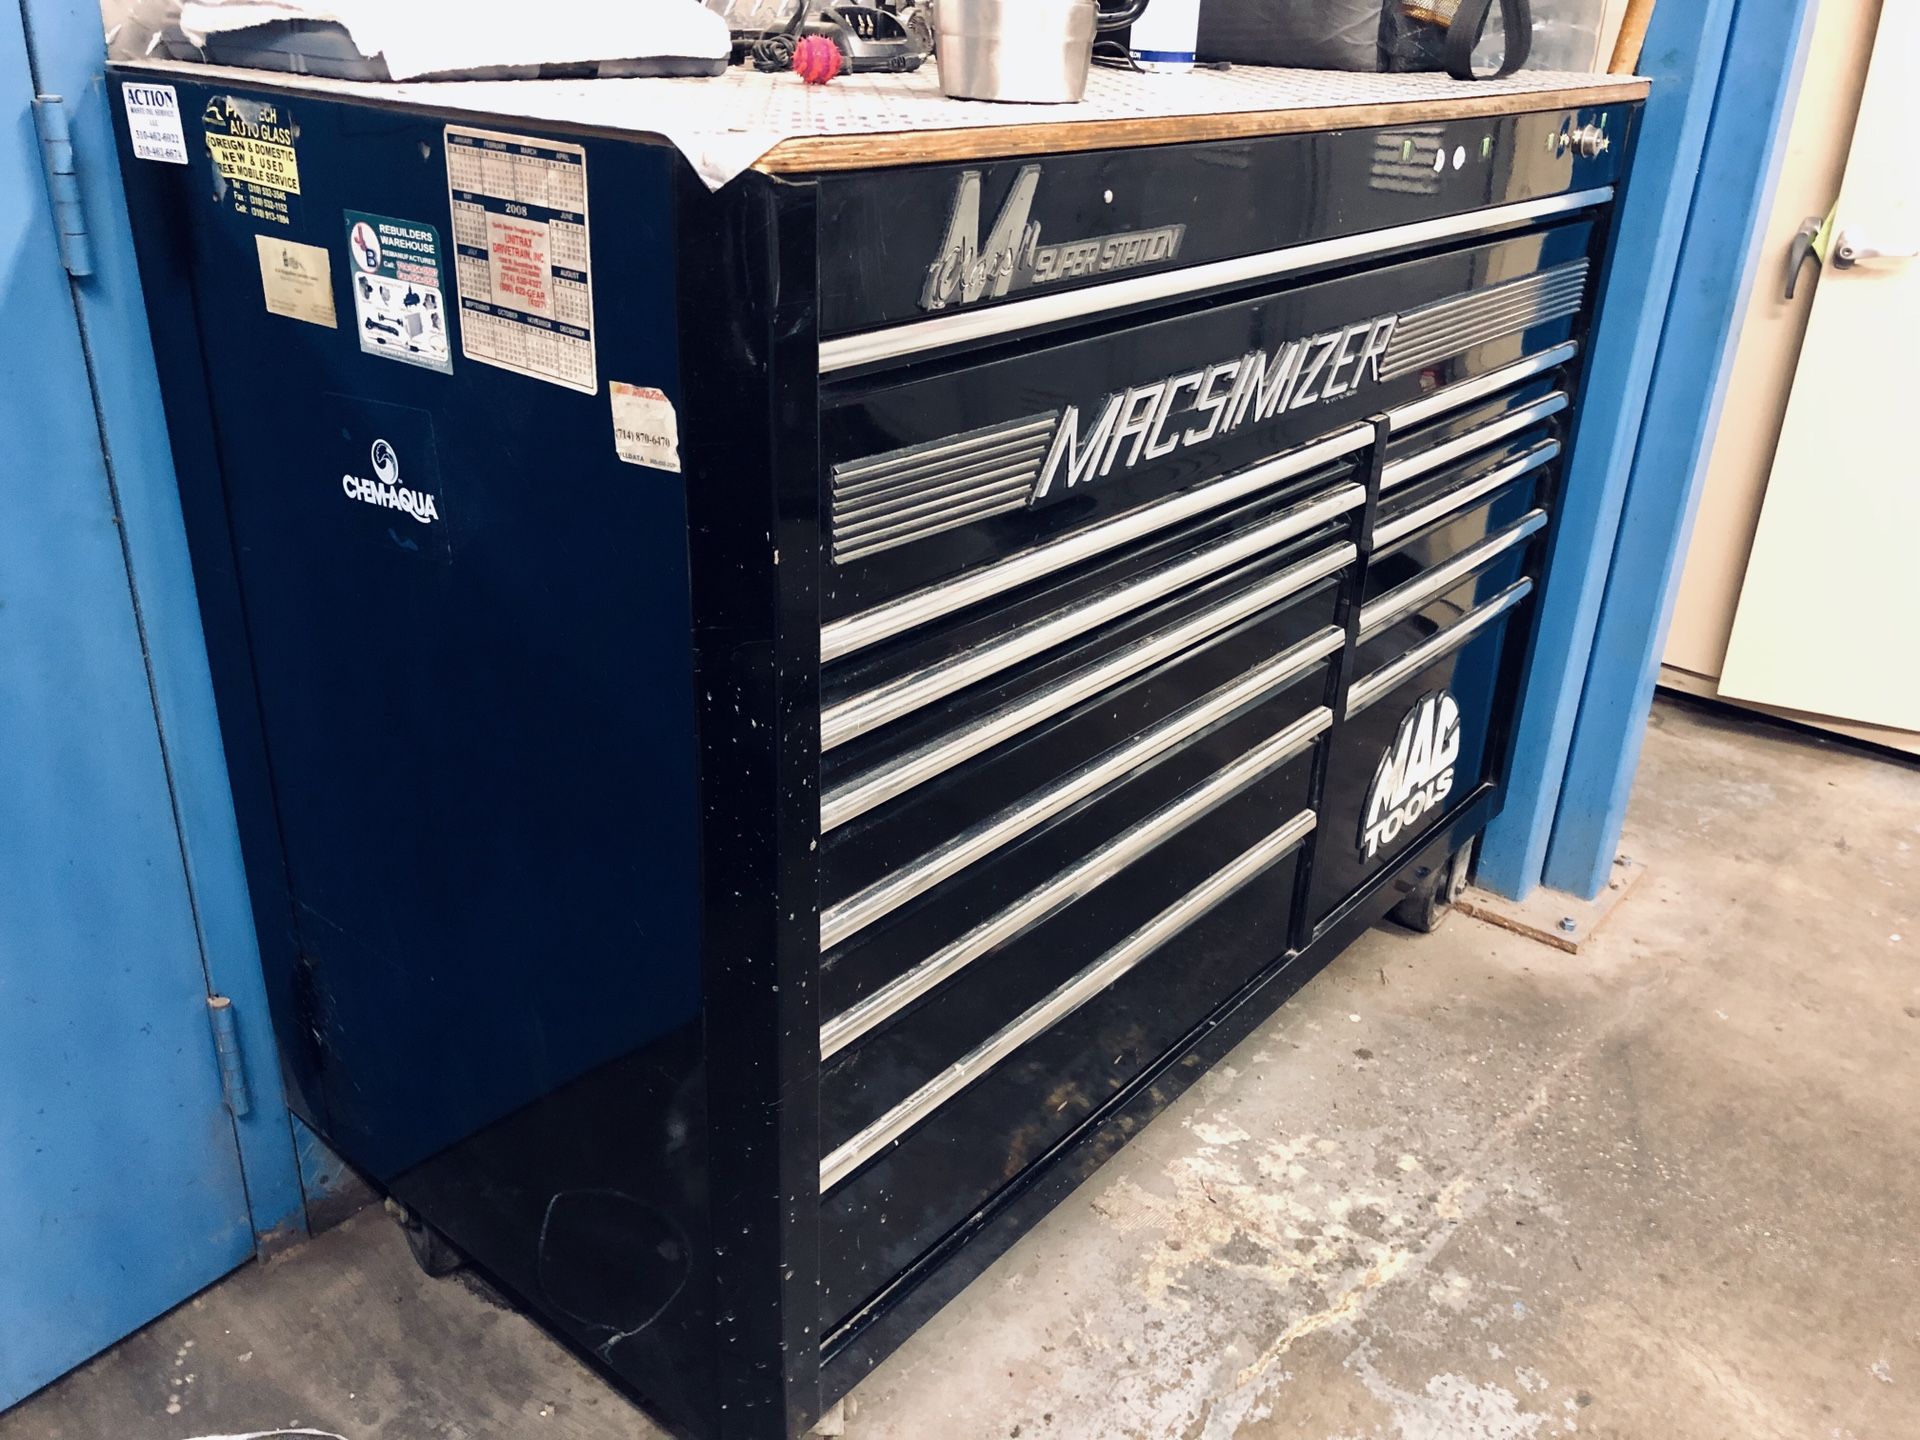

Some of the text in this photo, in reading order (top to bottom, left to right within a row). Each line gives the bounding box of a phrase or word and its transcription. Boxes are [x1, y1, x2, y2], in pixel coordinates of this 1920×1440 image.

[128, 89, 175, 107] ACTION
[230, 120, 291, 145] AUTO GLASS
[222, 151, 284, 173] NEW & USED
[247, 142, 253, 152] &
[255, 144, 294, 162] DOMESTIC
[520, 146, 537, 155] MARCH
[556, 152, 570, 162] APRIL
[217, 162, 298, 189] REE MOBILE SERVICE
[505, 203, 528, 217] 2008
[560, 212, 574, 221] JUNE
[379, 224, 433, 242] REBUILDERS
[380, 236, 435, 254] WAREHOUSE
[1031, 229, 1181, 284] SUPER STATION
[1032, 313, 1399, 502] MACSIMIZER
[616, 428, 634, 441] (714)
[1366, 692, 1460, 830] MAC
[1365, 767, 1454, 858] TOOLS
